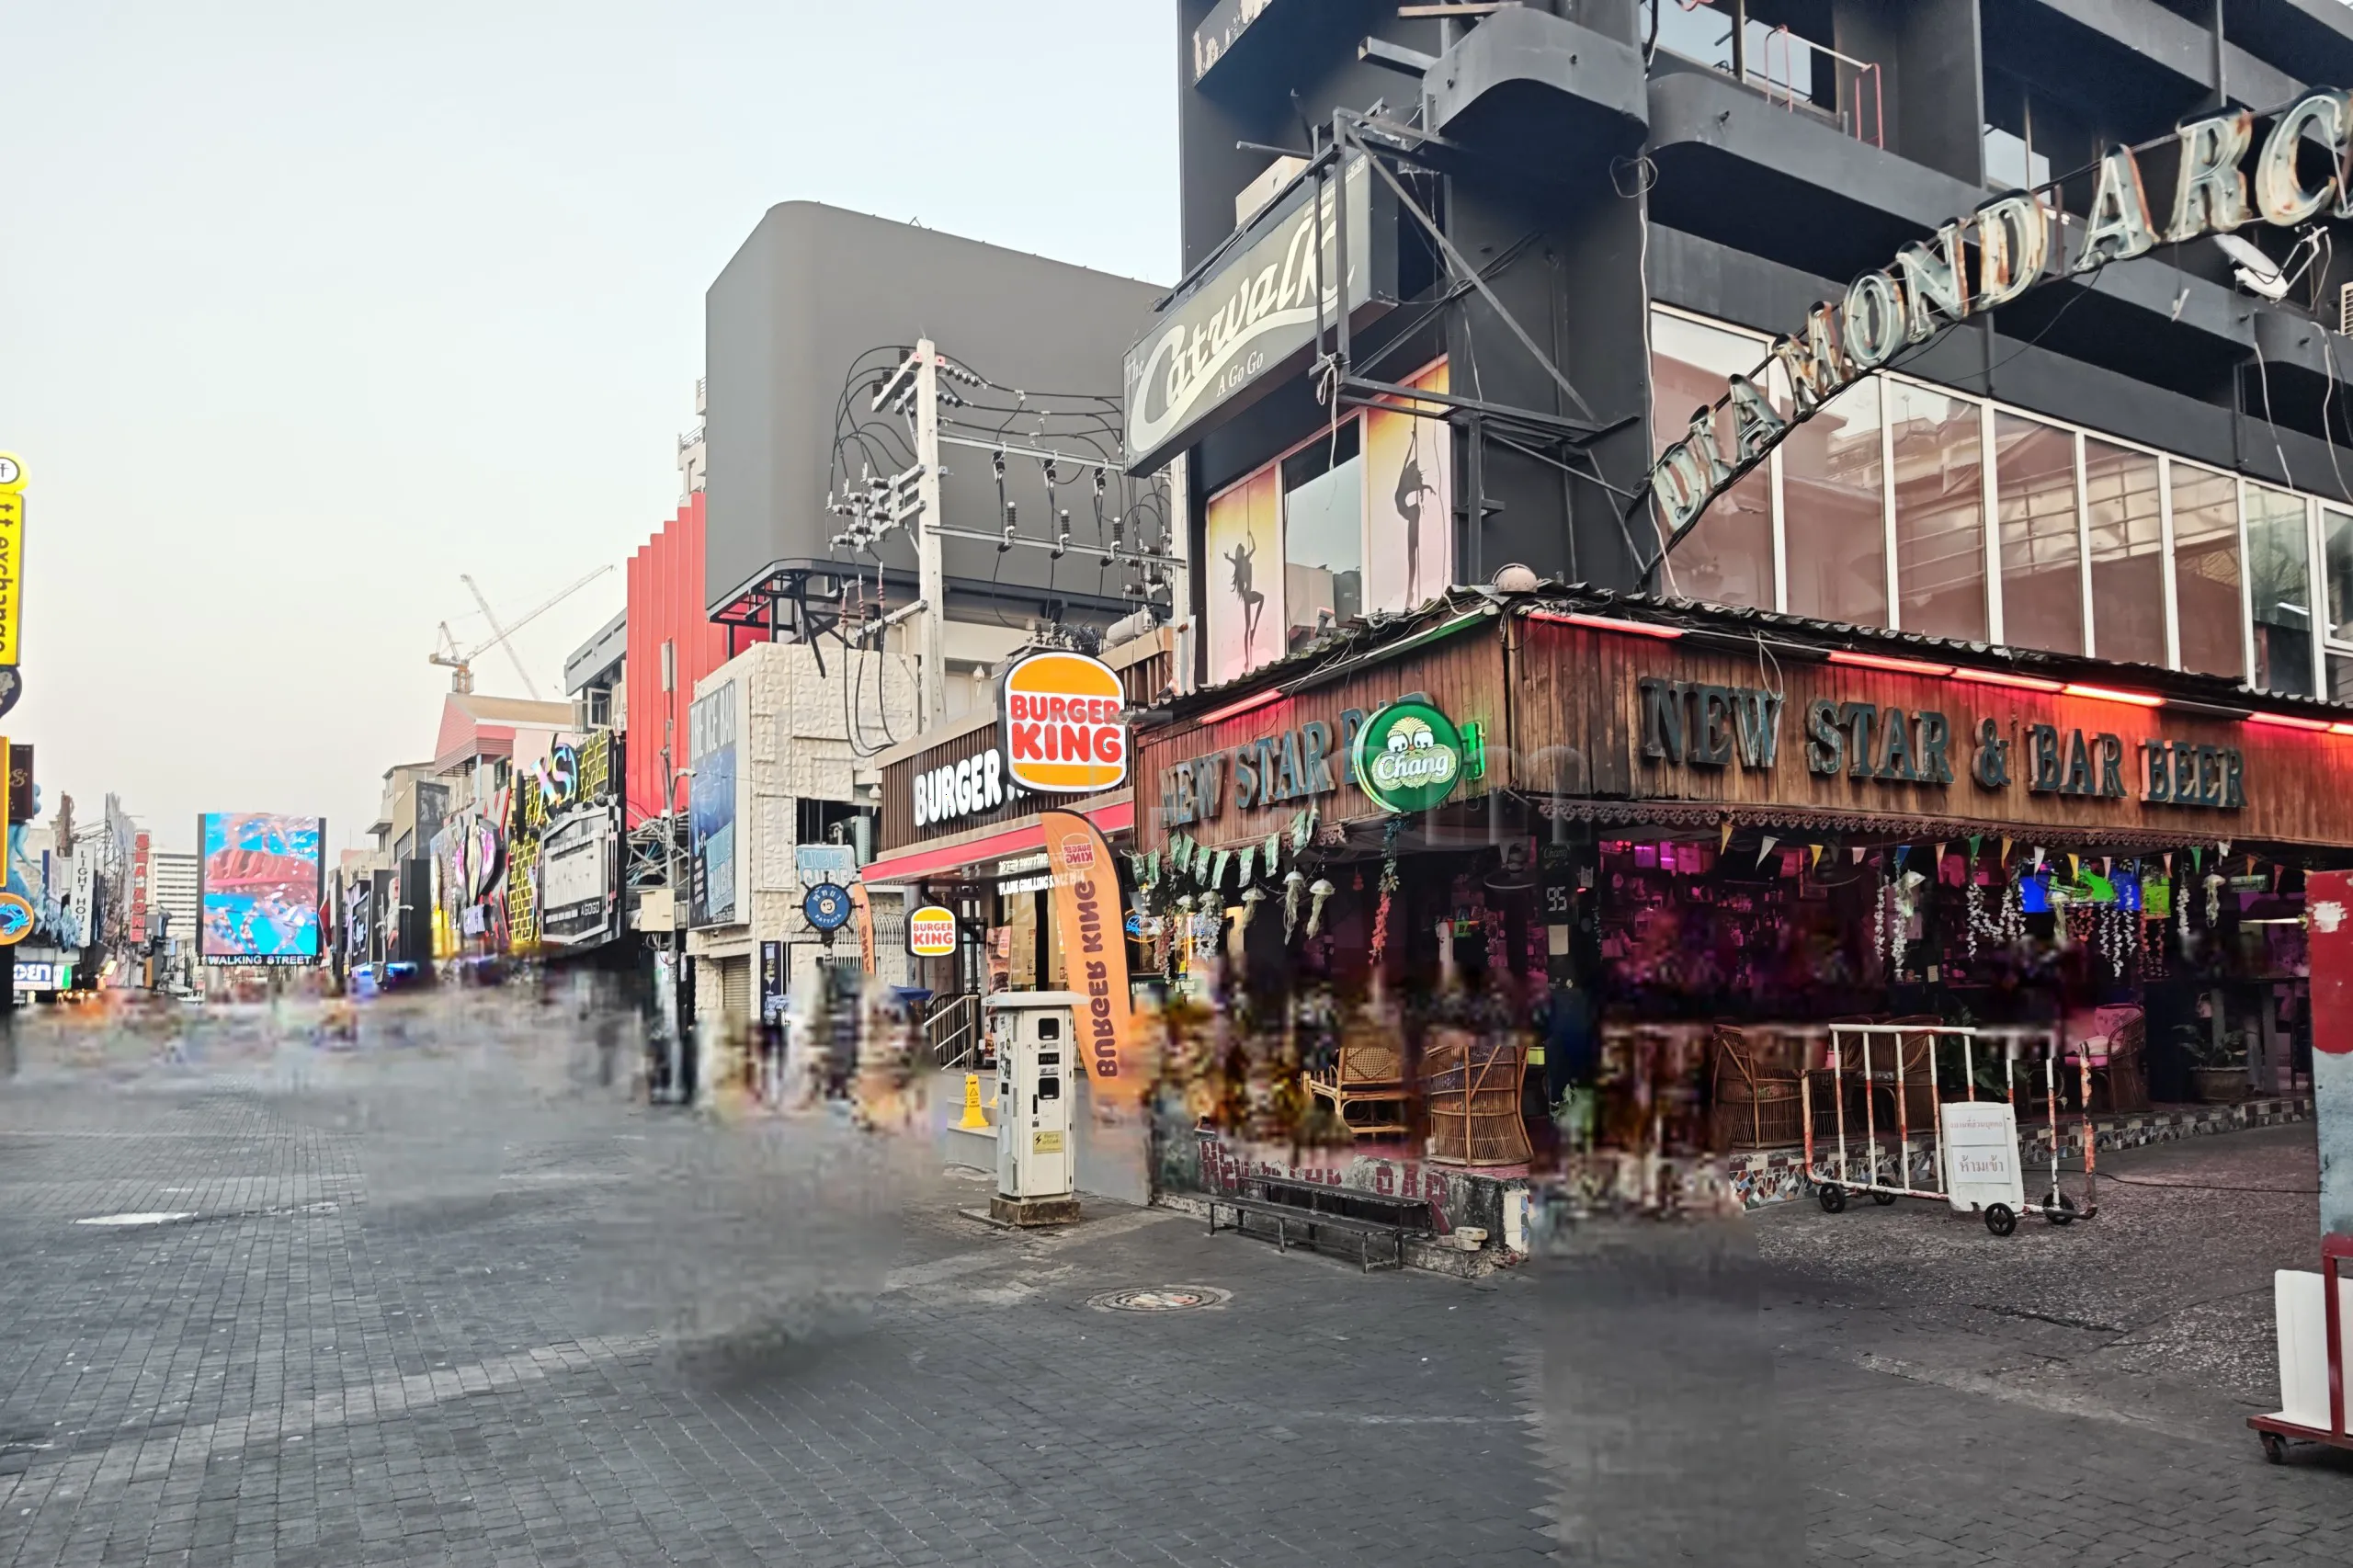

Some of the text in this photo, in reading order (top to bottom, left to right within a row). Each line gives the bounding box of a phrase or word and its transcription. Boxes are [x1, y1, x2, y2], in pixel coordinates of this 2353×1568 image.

[1130, 201, 1355, 452] Catwalk
[1654, 85, 2353, 533] DIAMOND ARC
[1126, 359, 1145, 387] The
[1216, 349, 1265, 398] A Go Go
[690, 683, 735, 761] THE ICE BAR
[1011, 694, 1120, 725] BURGER
[1012, 722, 1122, 763] KING
[1640, 676, 2249, 809] NEW STAR & BAR BEER
[915, 748, 1003, 827] BURGER
[1161, 754, 1226, 827] NEW
[1234, 720, 1336, 810] STAR
[1378, 754, 1449, 780] Chang
[77, 850, 88, 892] LIGHT
[581, 901, 600, 916] AGOGO
[913, 922, 953, 932] BURGER
[914, 932, 954, 945] KING
[208, 955, 312, 965] WALKING STREET
[1959, 1154, 2004, 1173] ห้ามเข้า
